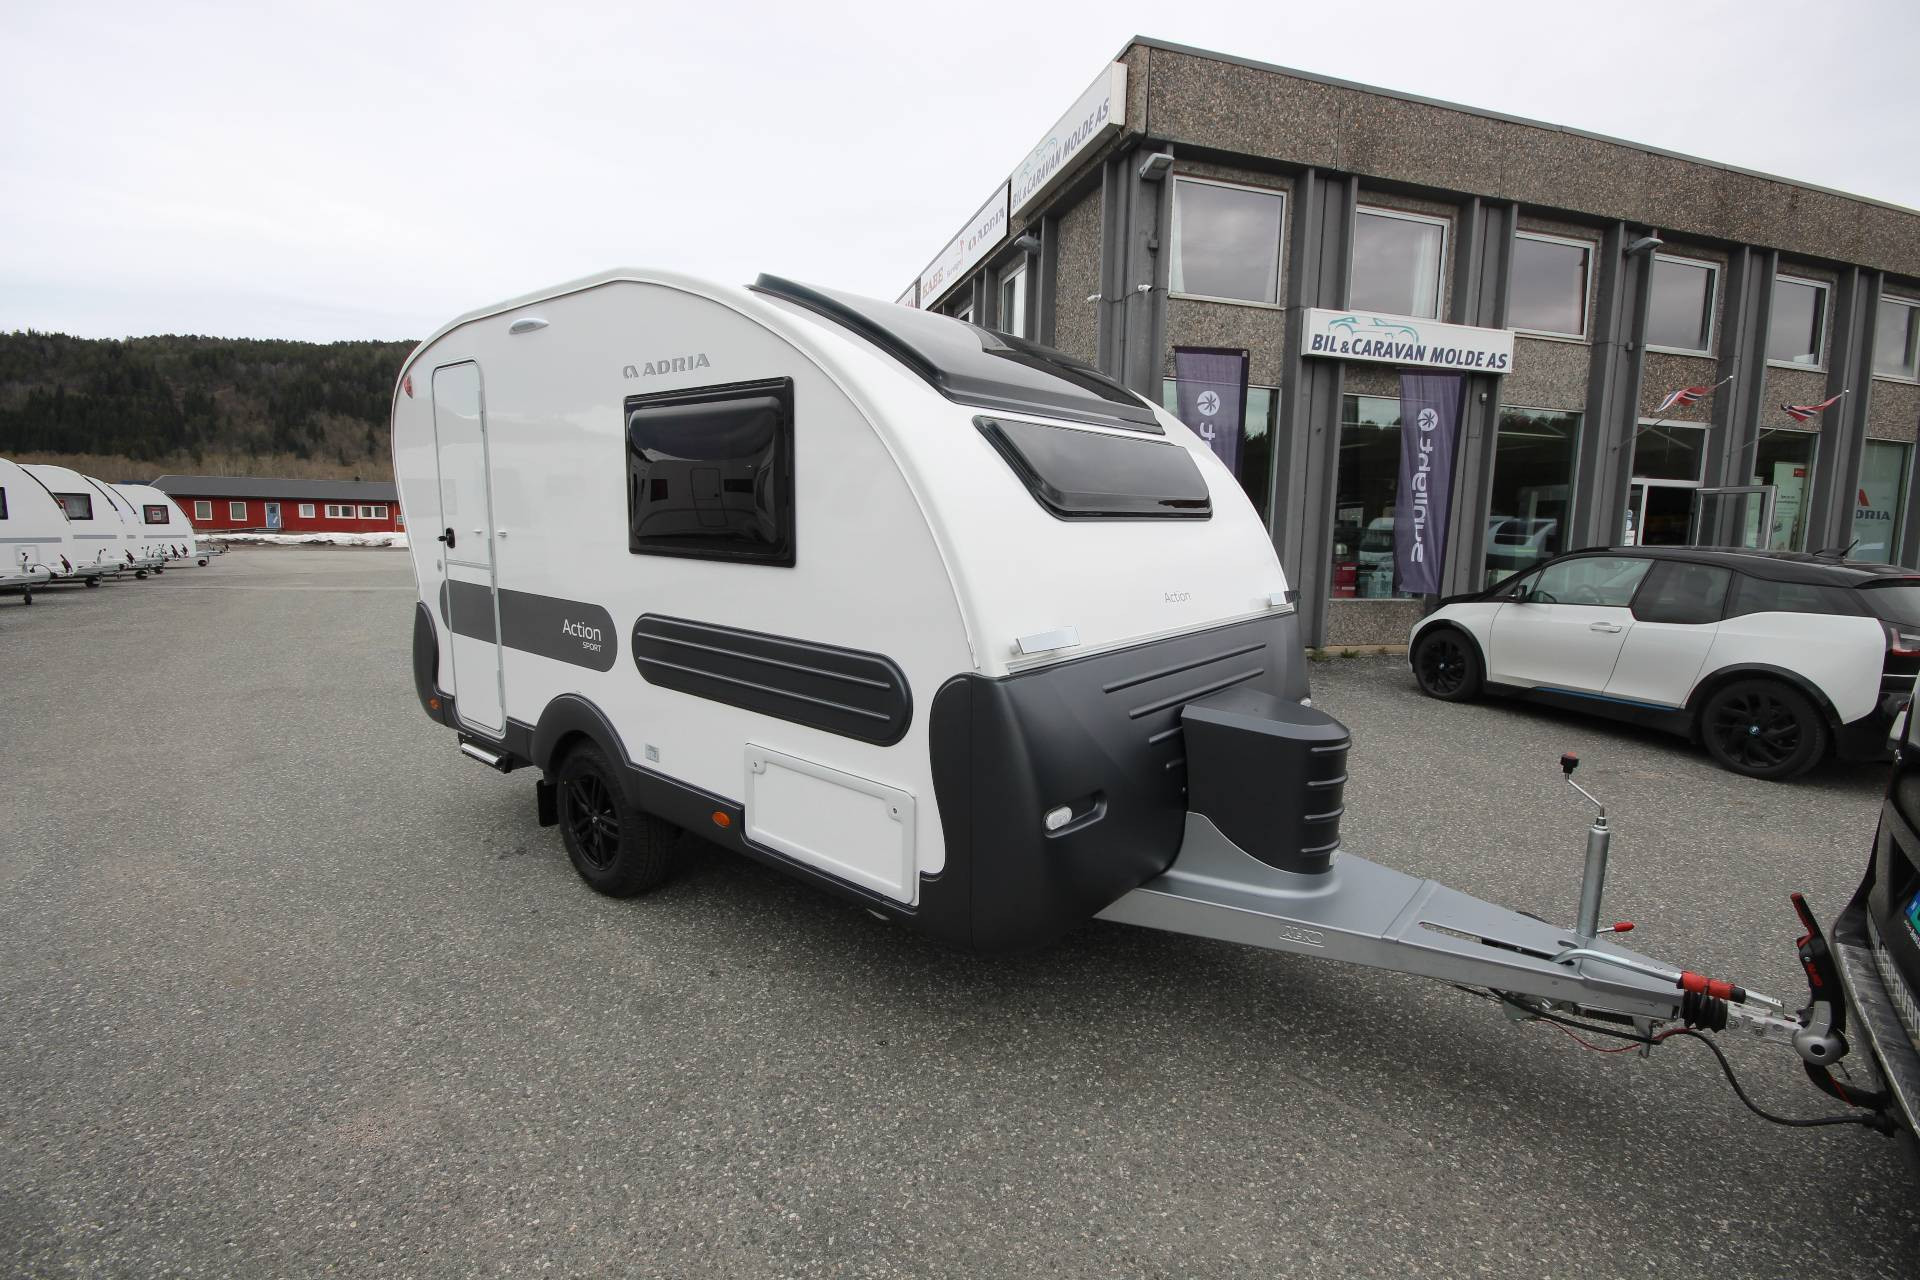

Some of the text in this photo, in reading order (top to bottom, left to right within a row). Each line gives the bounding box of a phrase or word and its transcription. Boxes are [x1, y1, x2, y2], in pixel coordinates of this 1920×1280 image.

[1026, 146, 1062, 194] CARAVAN
[1063, 112, 1095, 159] MOLDE
[1095, 97, 1109, 128] AS
[1311, 333, 1337, 353] BIL
[1351, 338, 1427, 362] CARAVAN
[1430, 346, 1485, 368] MOLDE
[1486, 352, 1508, 370] AS
[642, 353, 711, 376] ADRIA
[1855, 509, 1891, 521] DRIA
[1164, 590, 1192, 604] Action
[562, 619, 602, 642] Action
[582, 641, 602, 653] SPORT
